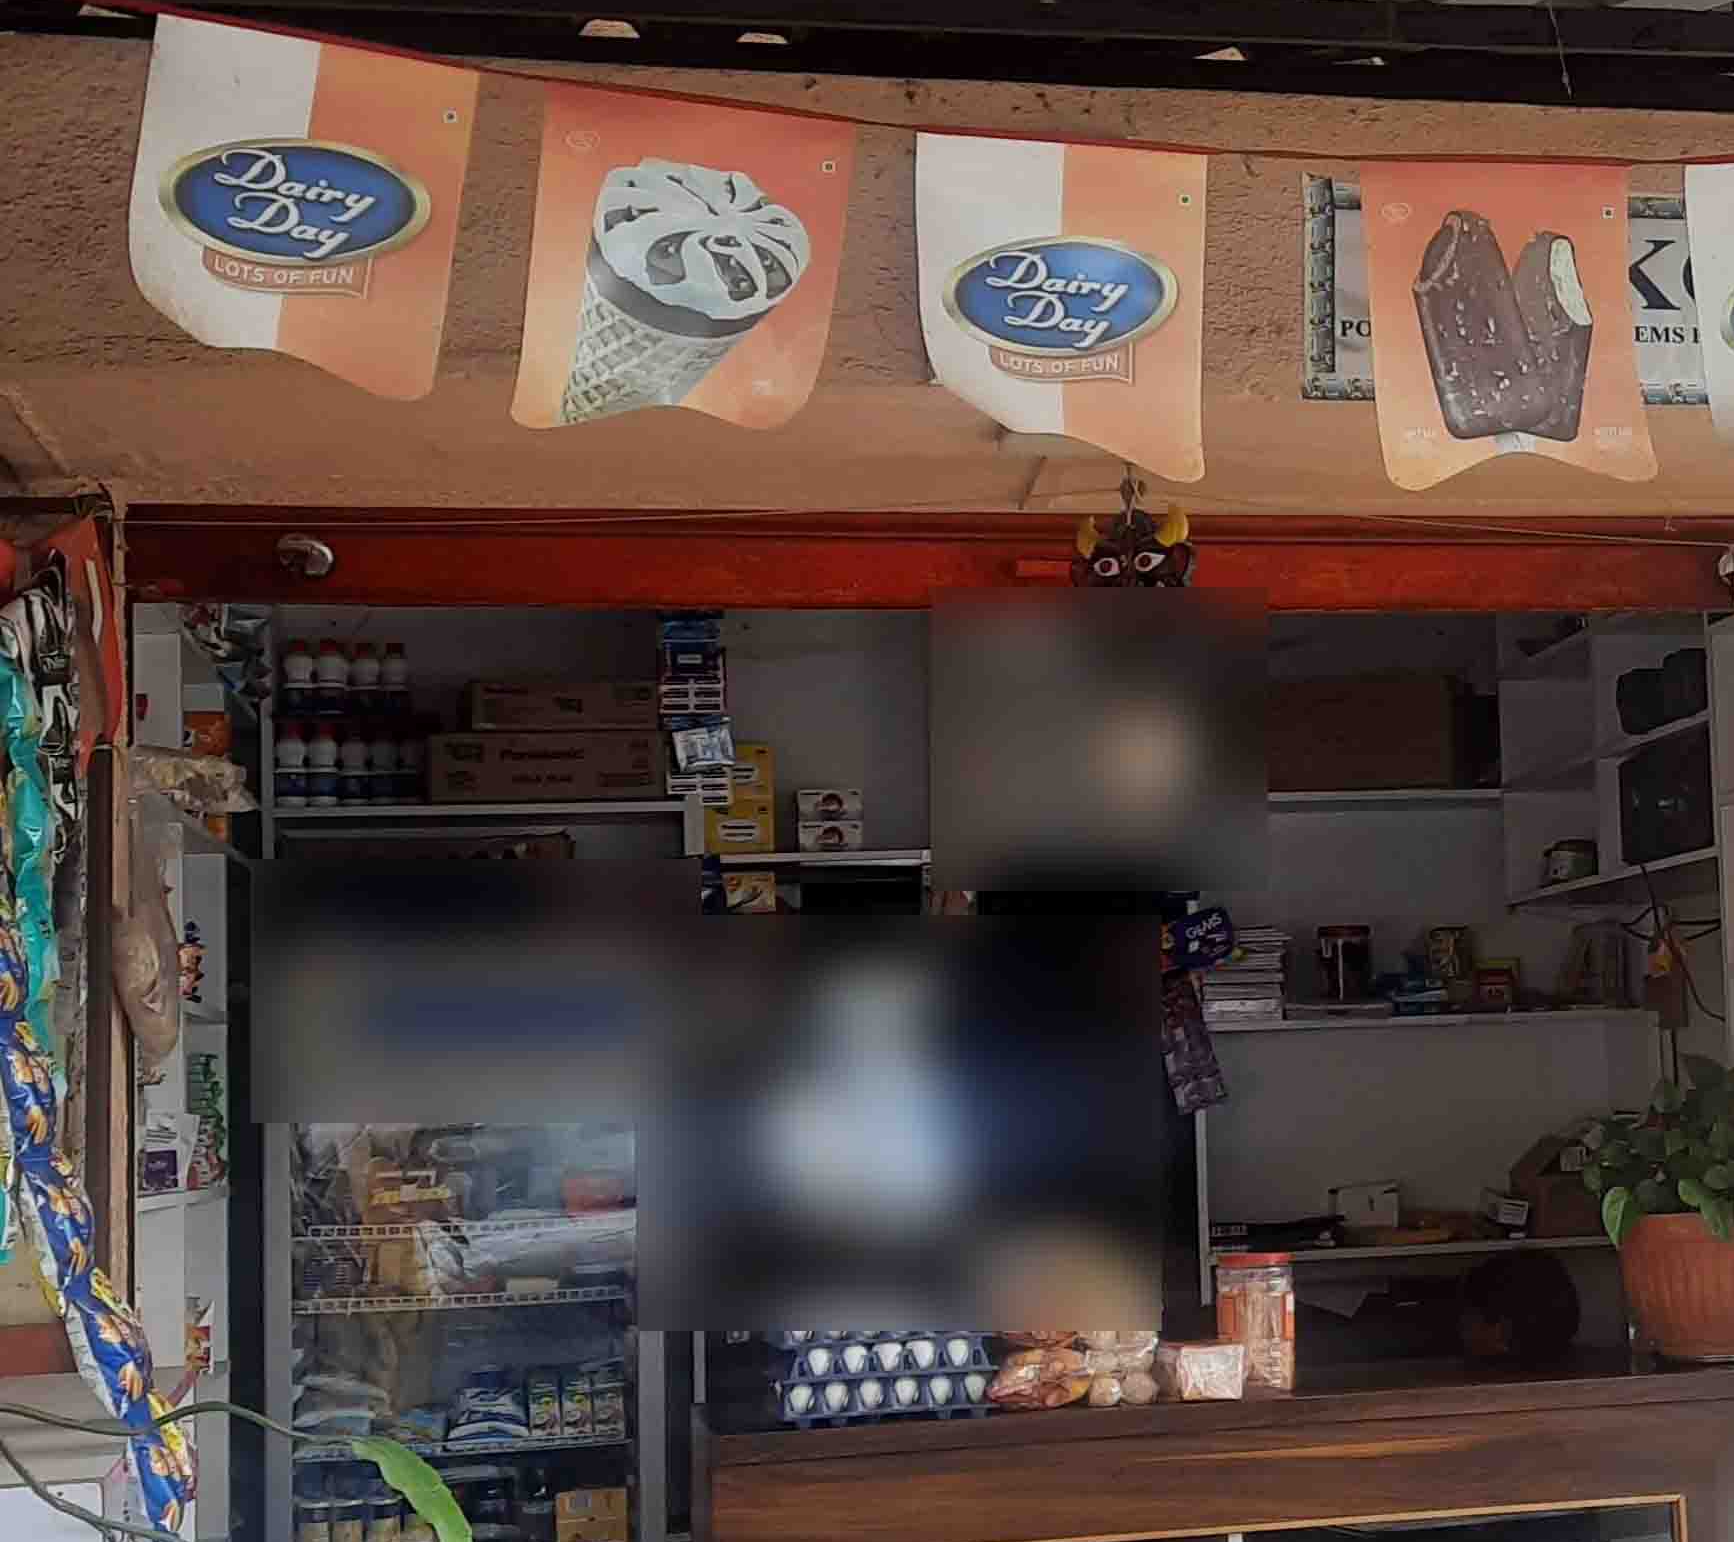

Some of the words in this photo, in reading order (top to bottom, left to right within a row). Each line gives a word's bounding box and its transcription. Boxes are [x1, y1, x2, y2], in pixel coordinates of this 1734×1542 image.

[212, 147, 377, 223] Dairy
[226, 191, 350, 261] Day
[212, 255, 270, 285] LOTS
[272, 266, 303, 286] OF
[307, 265, 355, 288] FUN
[983, 249, 1130, 312] Dairy
[1003, 291, 1112, 352] Day
[999, 352, 1044, 375] LOTS
[1051, 359, 1076, 375] OF
[1080, 354, 1121, 374] FUN
